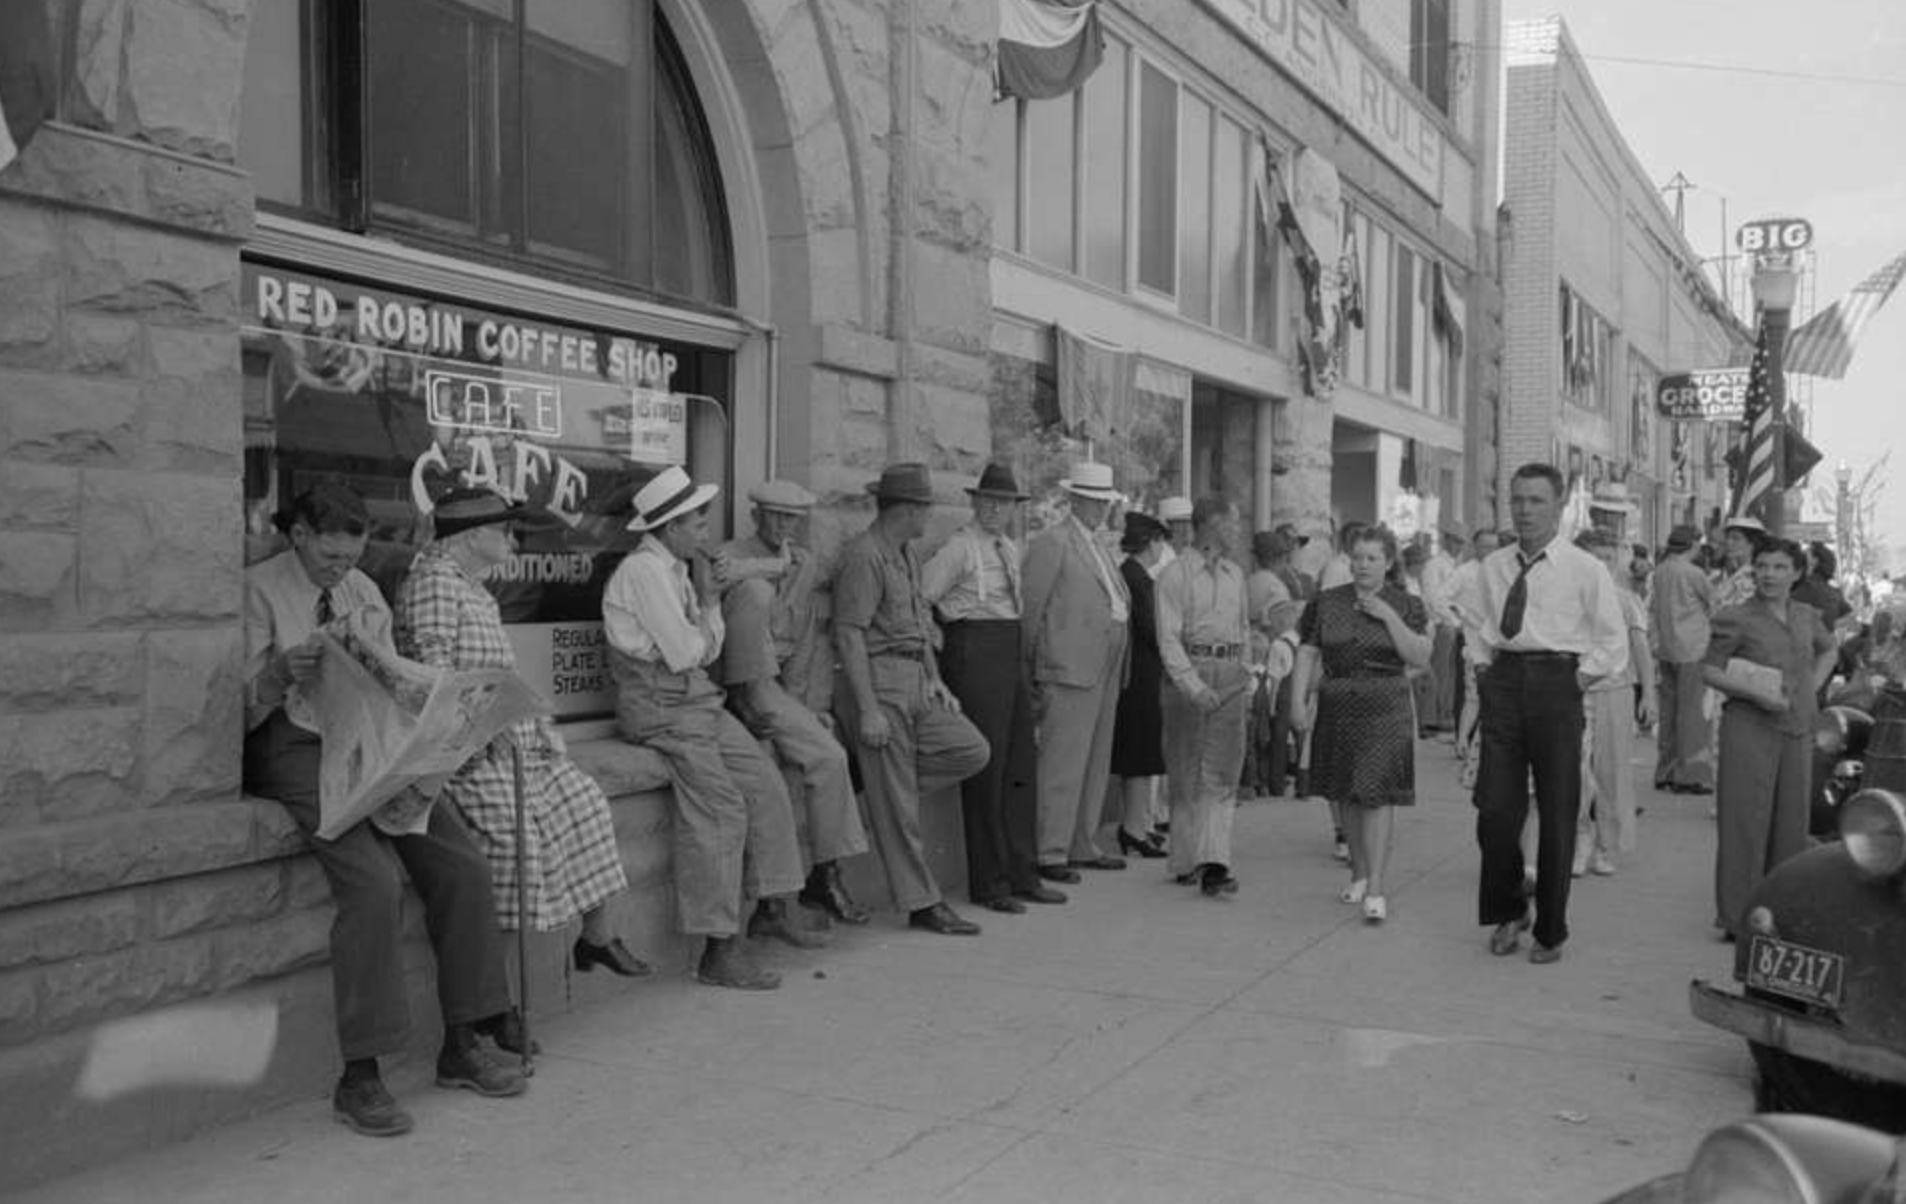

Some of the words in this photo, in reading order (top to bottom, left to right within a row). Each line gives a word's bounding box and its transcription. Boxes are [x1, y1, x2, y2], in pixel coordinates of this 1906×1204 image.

[1359, 60, 1434, 174] RULE
[1741, 223, 1808, 249] BIG
[257, 275, 338, 328] RED
[358, 298, 463, 353] ROBIN
[478, 320, 598, 371] COFFEE
[607, 336, 678, 383] SHOP
[431, 377, 557, 432] CAFE
[1661, 386, 1746, 406] GROCE
[412, 438, 588, 528] CAFE
[552, 652, 596, 672] PLATE
